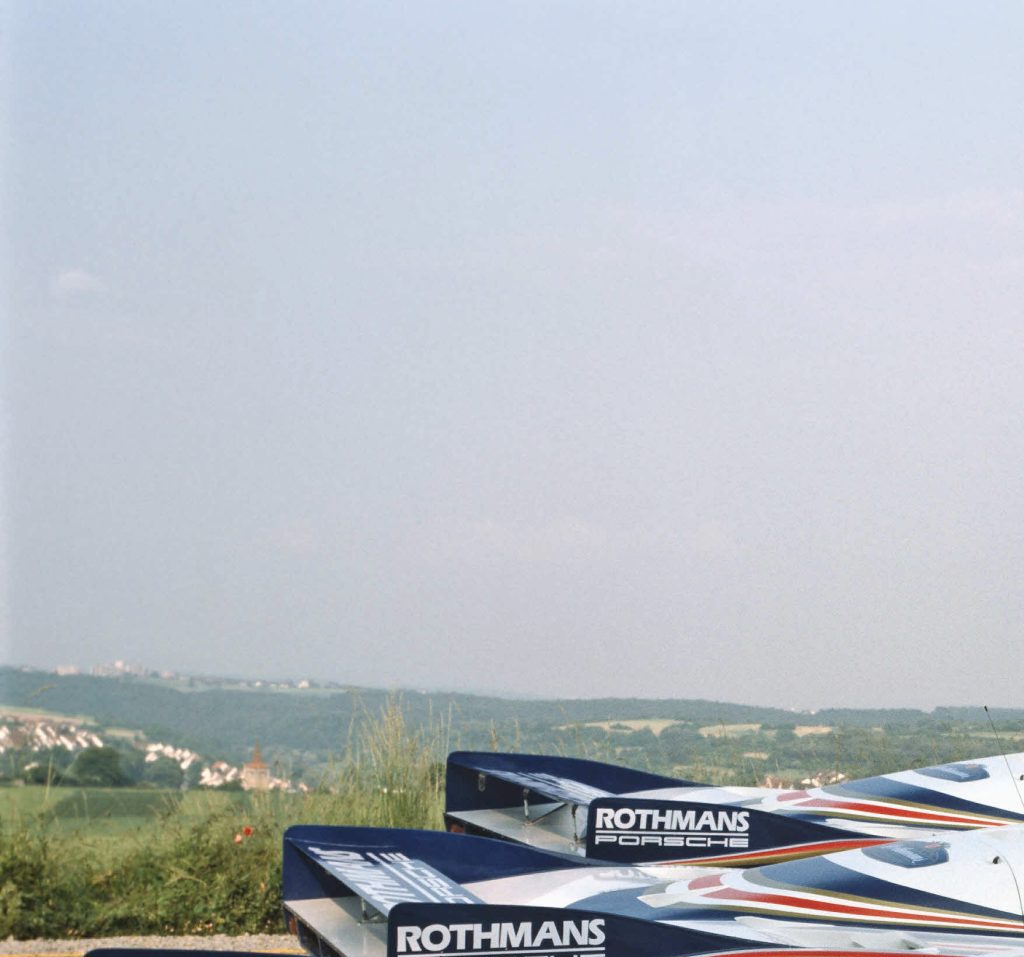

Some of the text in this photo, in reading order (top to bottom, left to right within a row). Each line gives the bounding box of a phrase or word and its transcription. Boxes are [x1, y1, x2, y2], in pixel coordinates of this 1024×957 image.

[595, 807, 750, 831] ROTHMANS
[594, 834, 749, 847] PORSCHE
[396, 918, 606, 953] ROTHMANS
